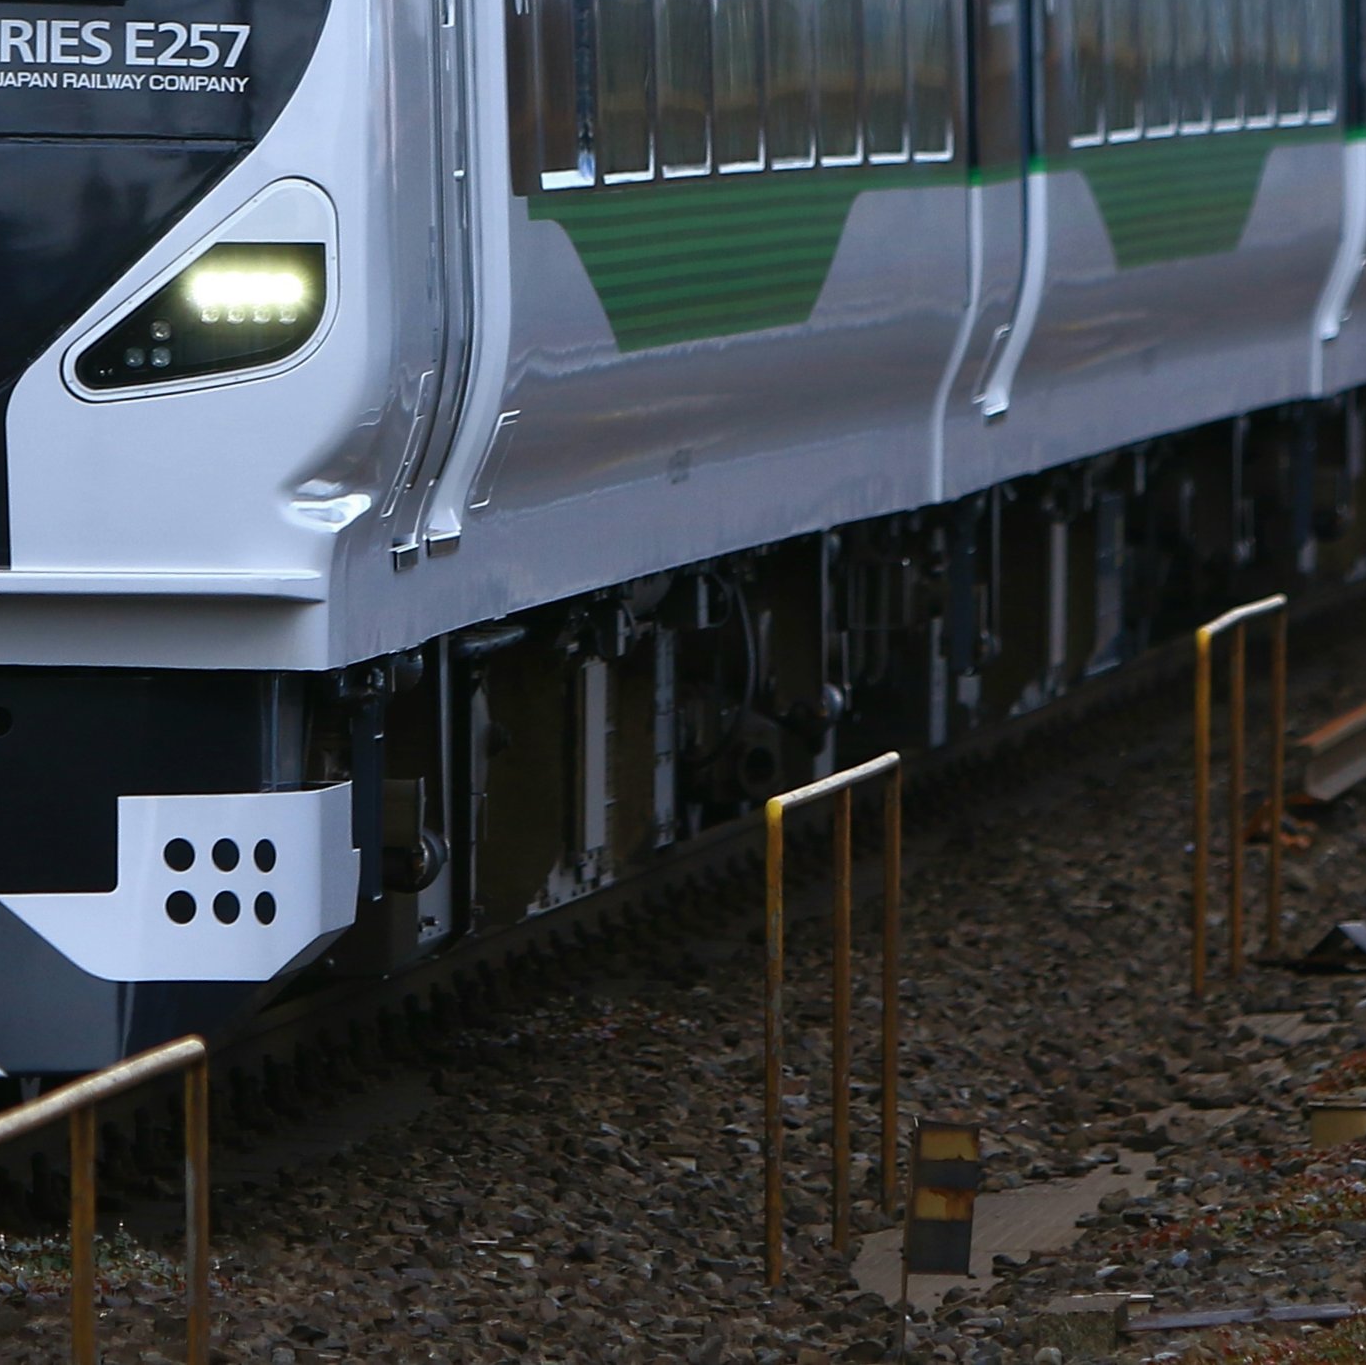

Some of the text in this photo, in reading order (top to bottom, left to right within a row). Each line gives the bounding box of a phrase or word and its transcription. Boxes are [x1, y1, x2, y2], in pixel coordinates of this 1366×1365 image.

[125, 21, 251, 68] E257
[63, 73, 146, 90] RAILWAY
[149, 75, 250, 93] COMPANY
